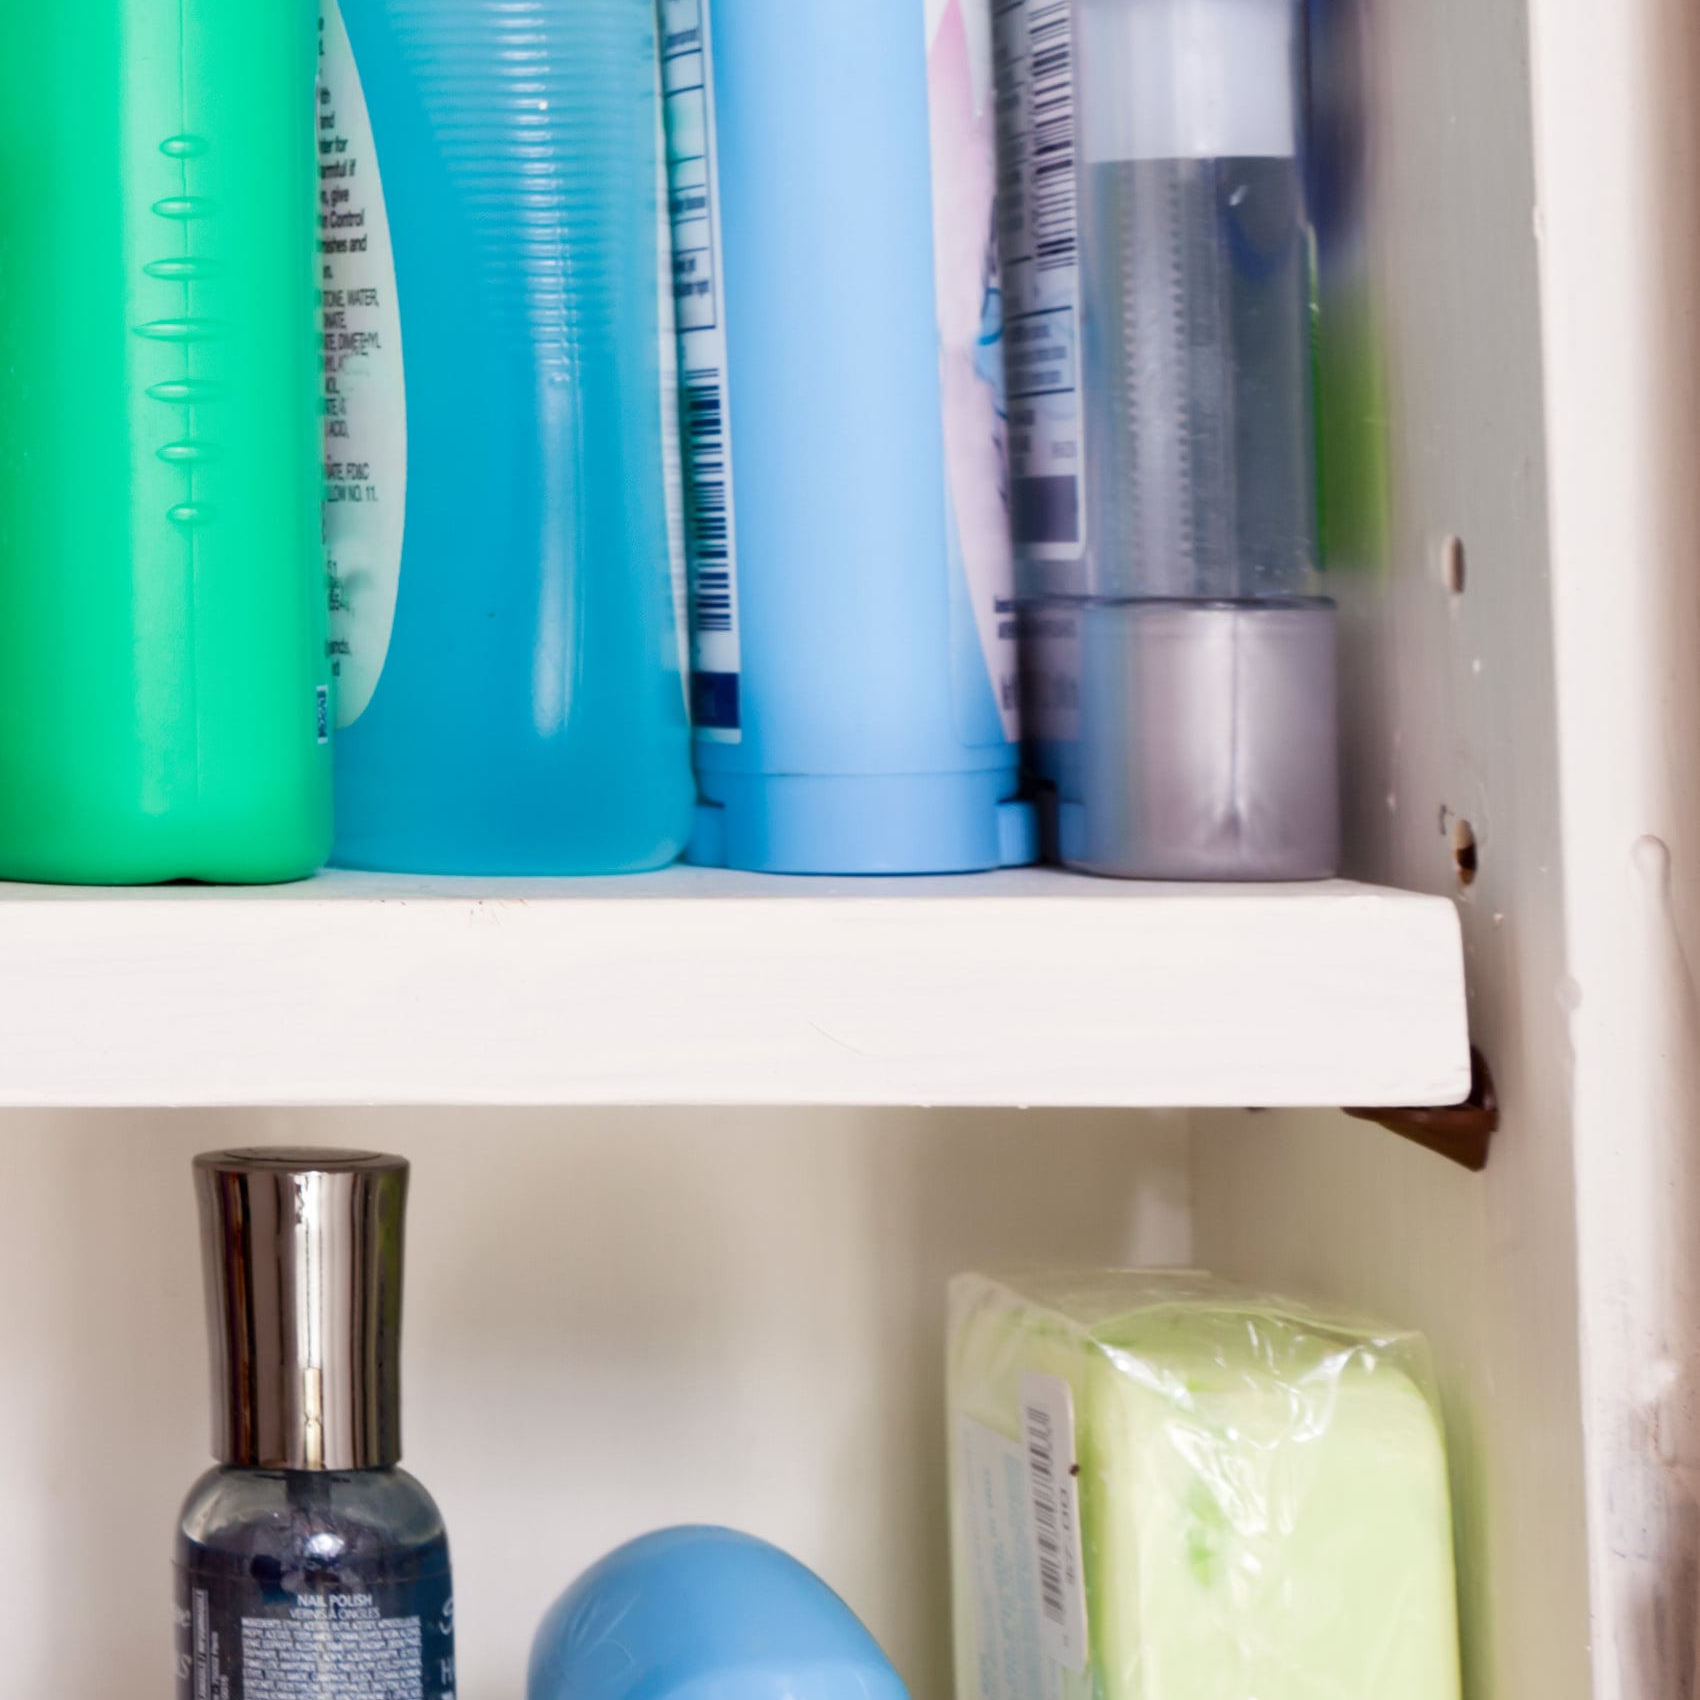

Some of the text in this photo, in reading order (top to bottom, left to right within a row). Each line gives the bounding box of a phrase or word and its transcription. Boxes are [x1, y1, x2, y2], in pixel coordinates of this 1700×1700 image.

[330, 208, 365, 229] Control
[297, 1593, 373, 1608] NAIL POLISH
